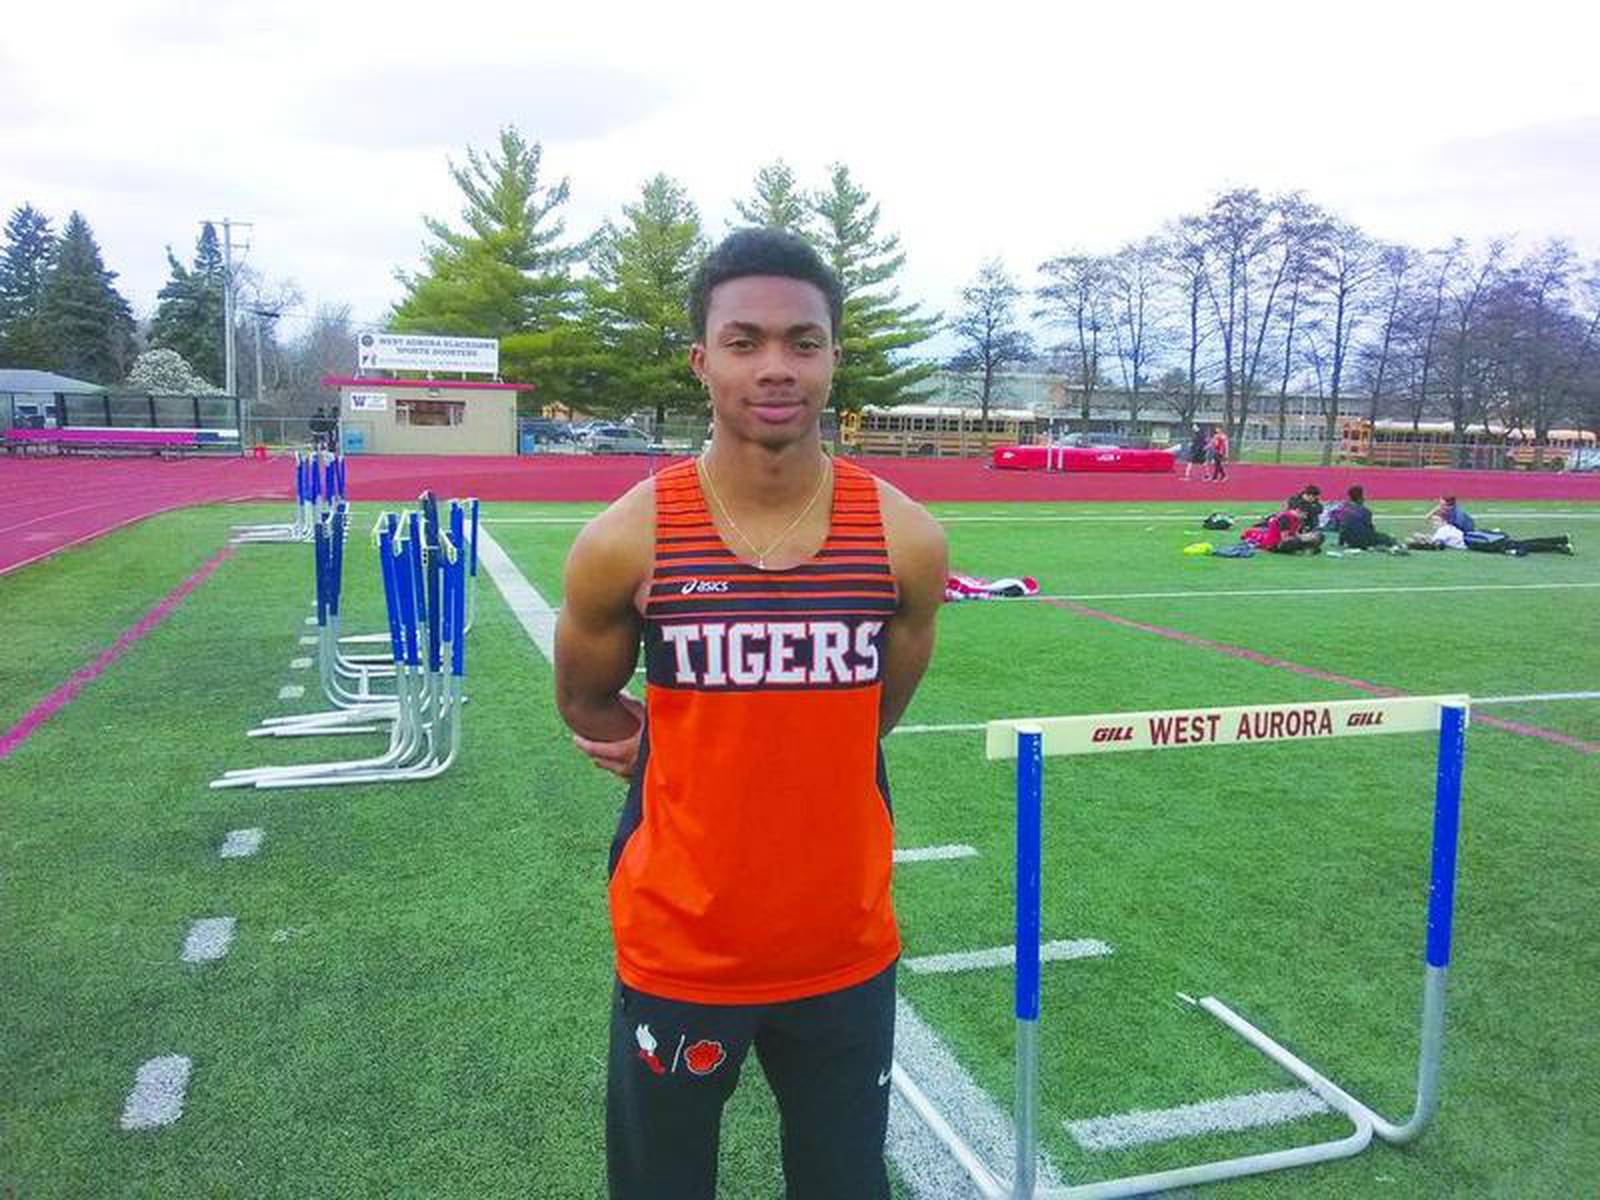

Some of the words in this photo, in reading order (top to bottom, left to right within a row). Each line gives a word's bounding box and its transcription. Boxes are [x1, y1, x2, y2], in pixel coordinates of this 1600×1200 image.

[661, 621, 885, 685] TIGERS
[1092, 726, 1134, 742] GILL
[1149, 714, 1221, 746] WEST
[1236, 708, 1334, 740] AURORA
[1346, 711, 1385, 727] GILL
